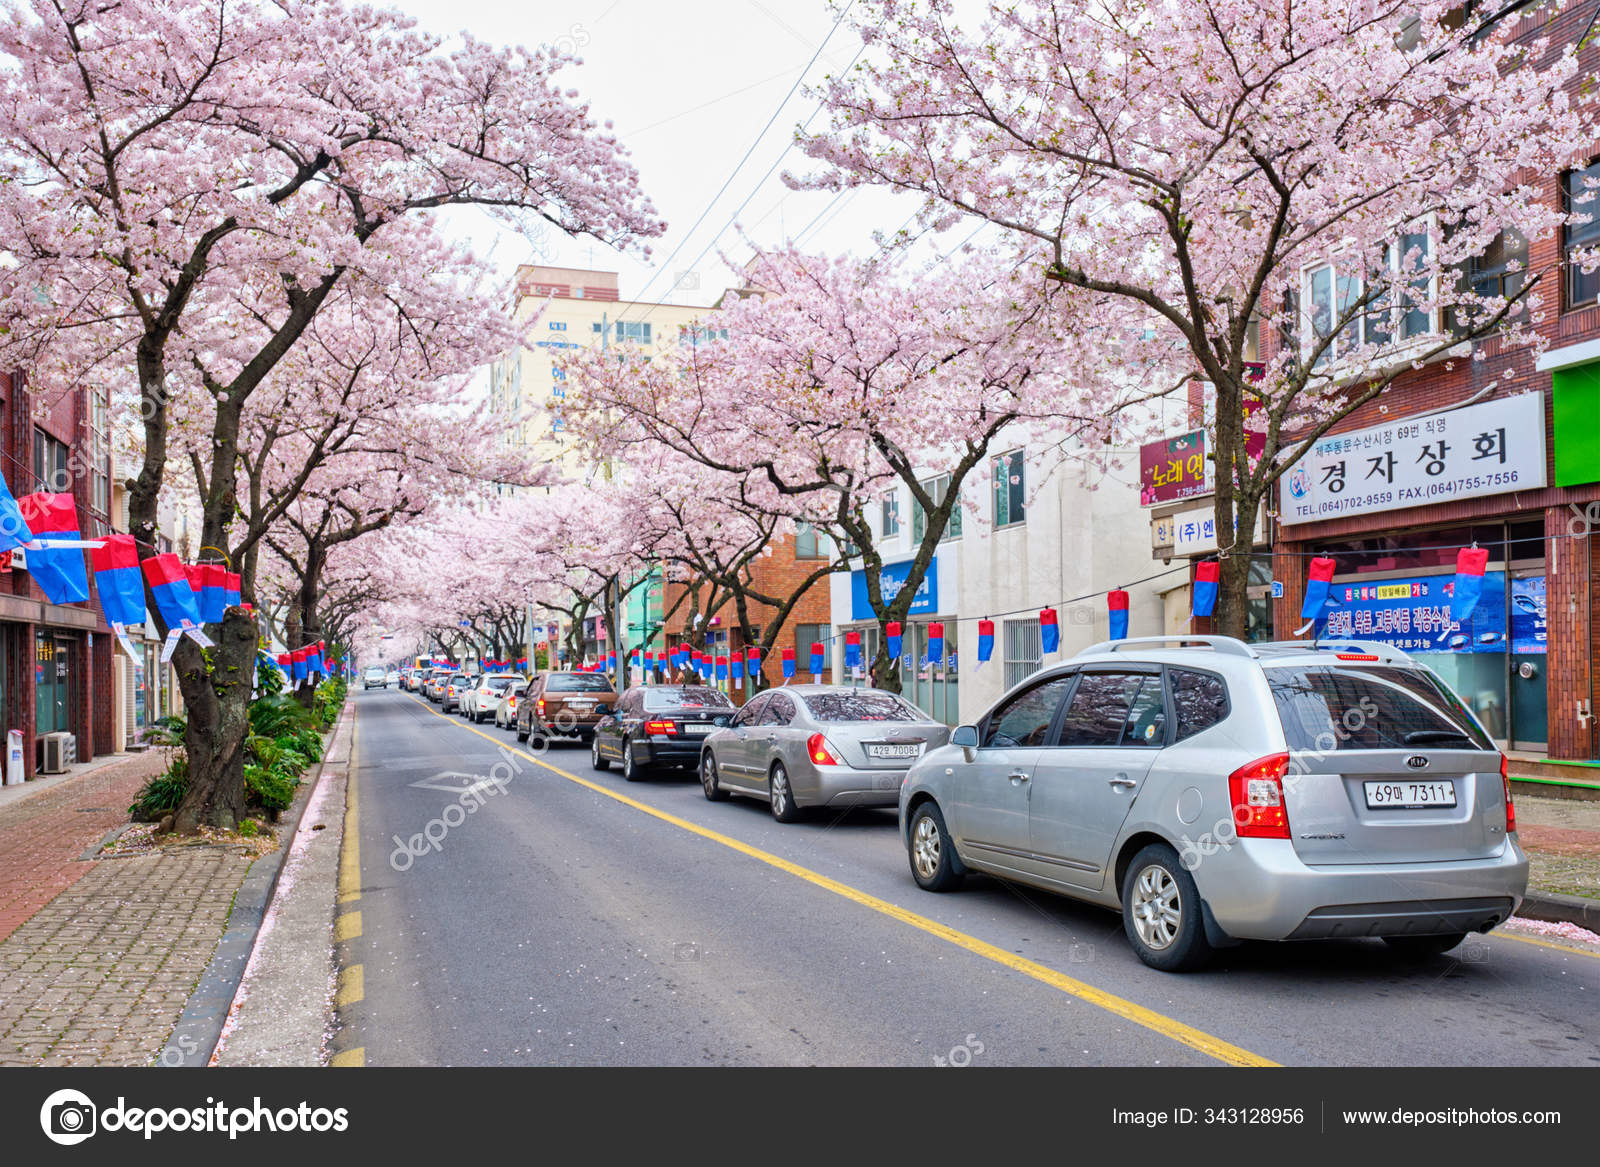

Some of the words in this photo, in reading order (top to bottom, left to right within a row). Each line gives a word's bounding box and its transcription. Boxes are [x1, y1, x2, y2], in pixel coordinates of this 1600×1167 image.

[1397, 423, 1424, 439] 69번
[1426, 417, 1446, 434] 직영
[1320, 428, 1507, 493] 경자상회
[1296, 492, 1393, 516] TEL.(064)702-9559
[1398, 470, 1519, 501] FAX.(064)755-7556
[1412, 583, 1429, 596] 가능
[1410, 756, 1428, 768] KIA
[1375, 784, 1403, 802] 69마
[1409, 784, 1446, 801] 7311
